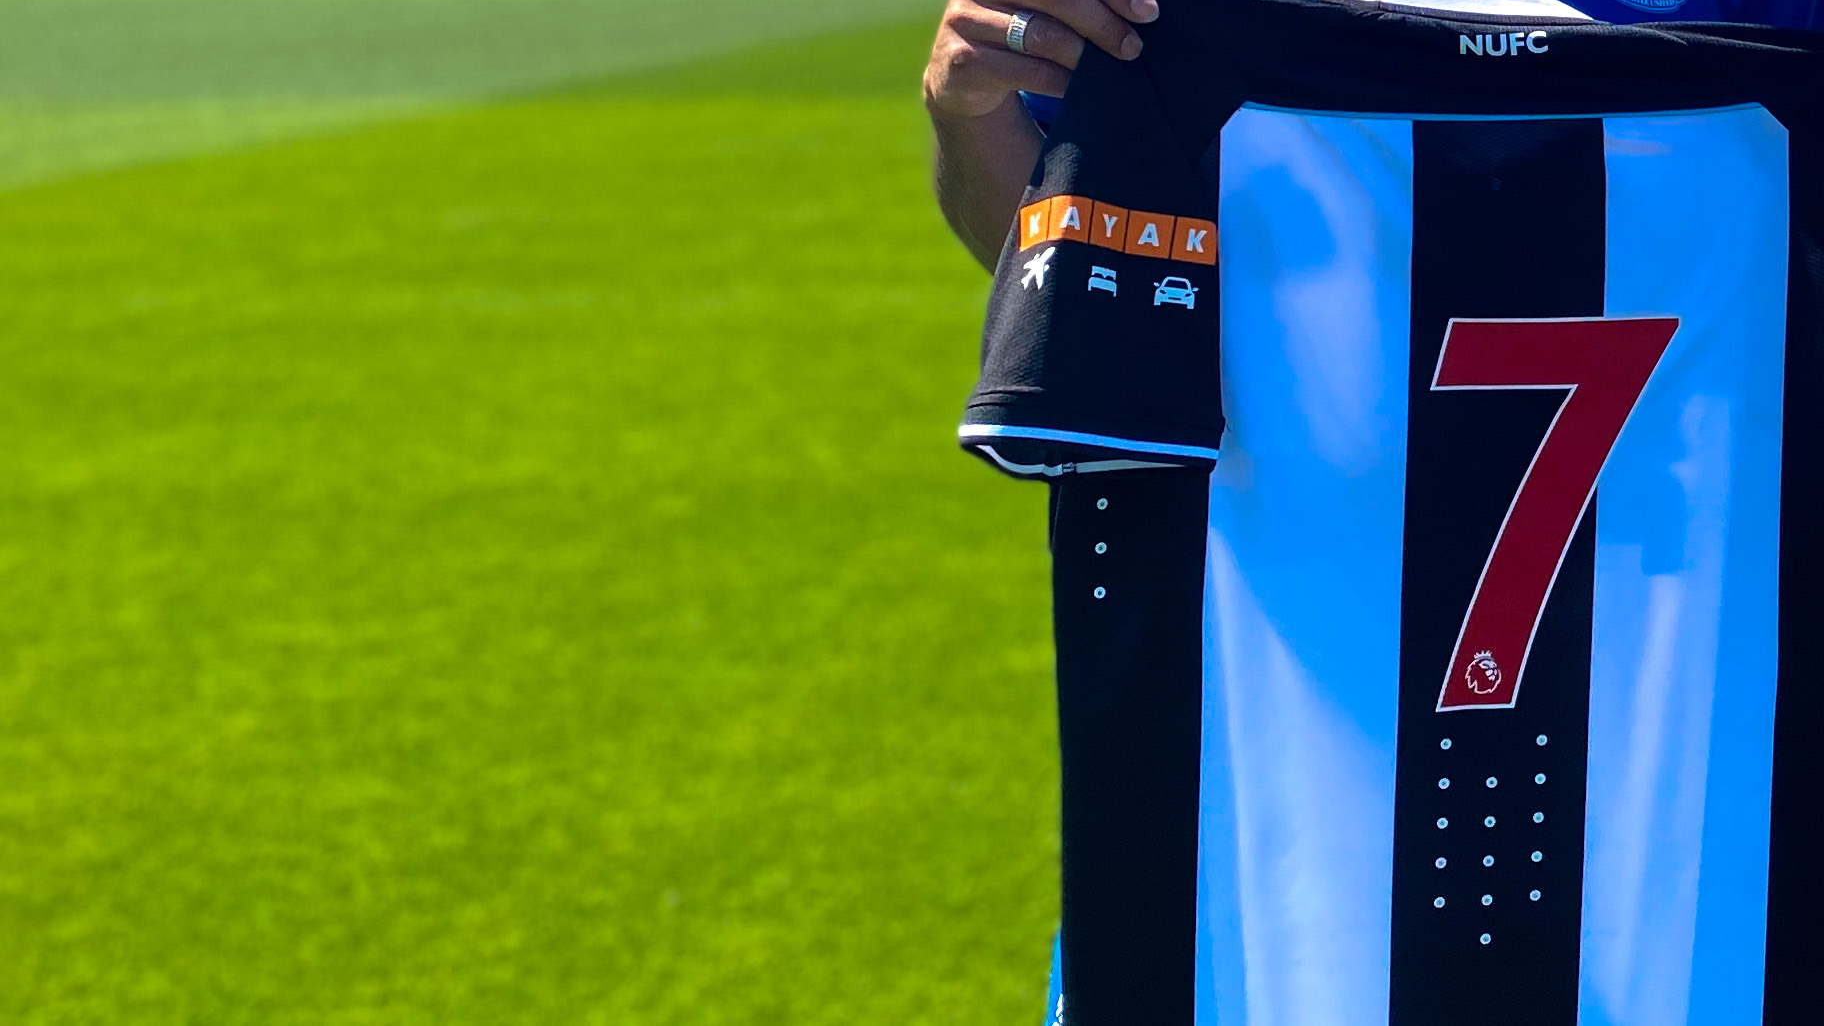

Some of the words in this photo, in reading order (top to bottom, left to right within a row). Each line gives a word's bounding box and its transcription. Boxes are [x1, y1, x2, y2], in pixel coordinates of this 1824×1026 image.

[1459, 30, 1549, 57] NUFC
[1029, 205, 1205, 254] KAYAK
[1430, 317, 1680, 713] 7
